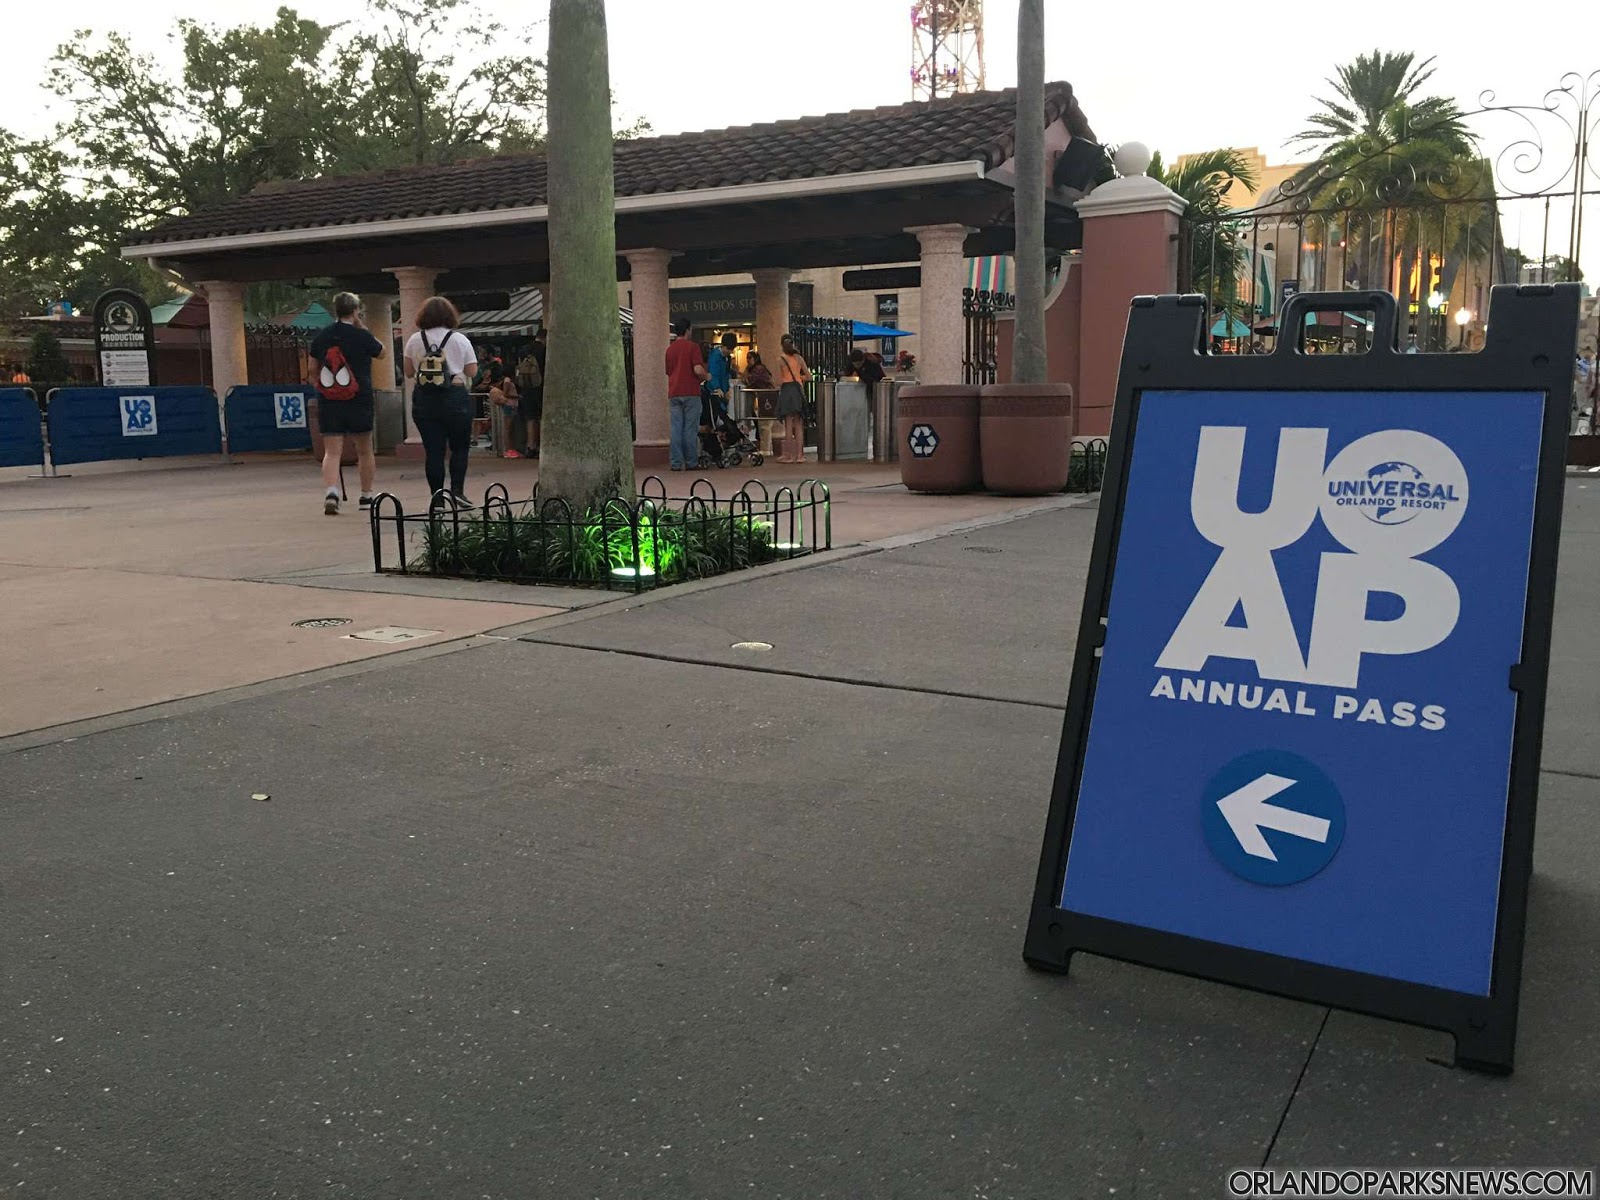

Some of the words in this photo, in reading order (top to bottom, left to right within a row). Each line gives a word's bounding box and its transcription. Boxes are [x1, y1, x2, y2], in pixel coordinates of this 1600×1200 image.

[693, 299, 735, 312] STUDIOS
[738, 298, 756, 310] STO
[100, 332, 145, 342] PRODUCTION
[1328, 480, 1460, 502] UNIVERSAL
[1336, 497, 1396, 507] ORLANDO
[1401, 499, 1447, 511] RESORT
[1149, 674, 1317, 717] ANNUAL
[1332, 695, 1447, 732] PASS
